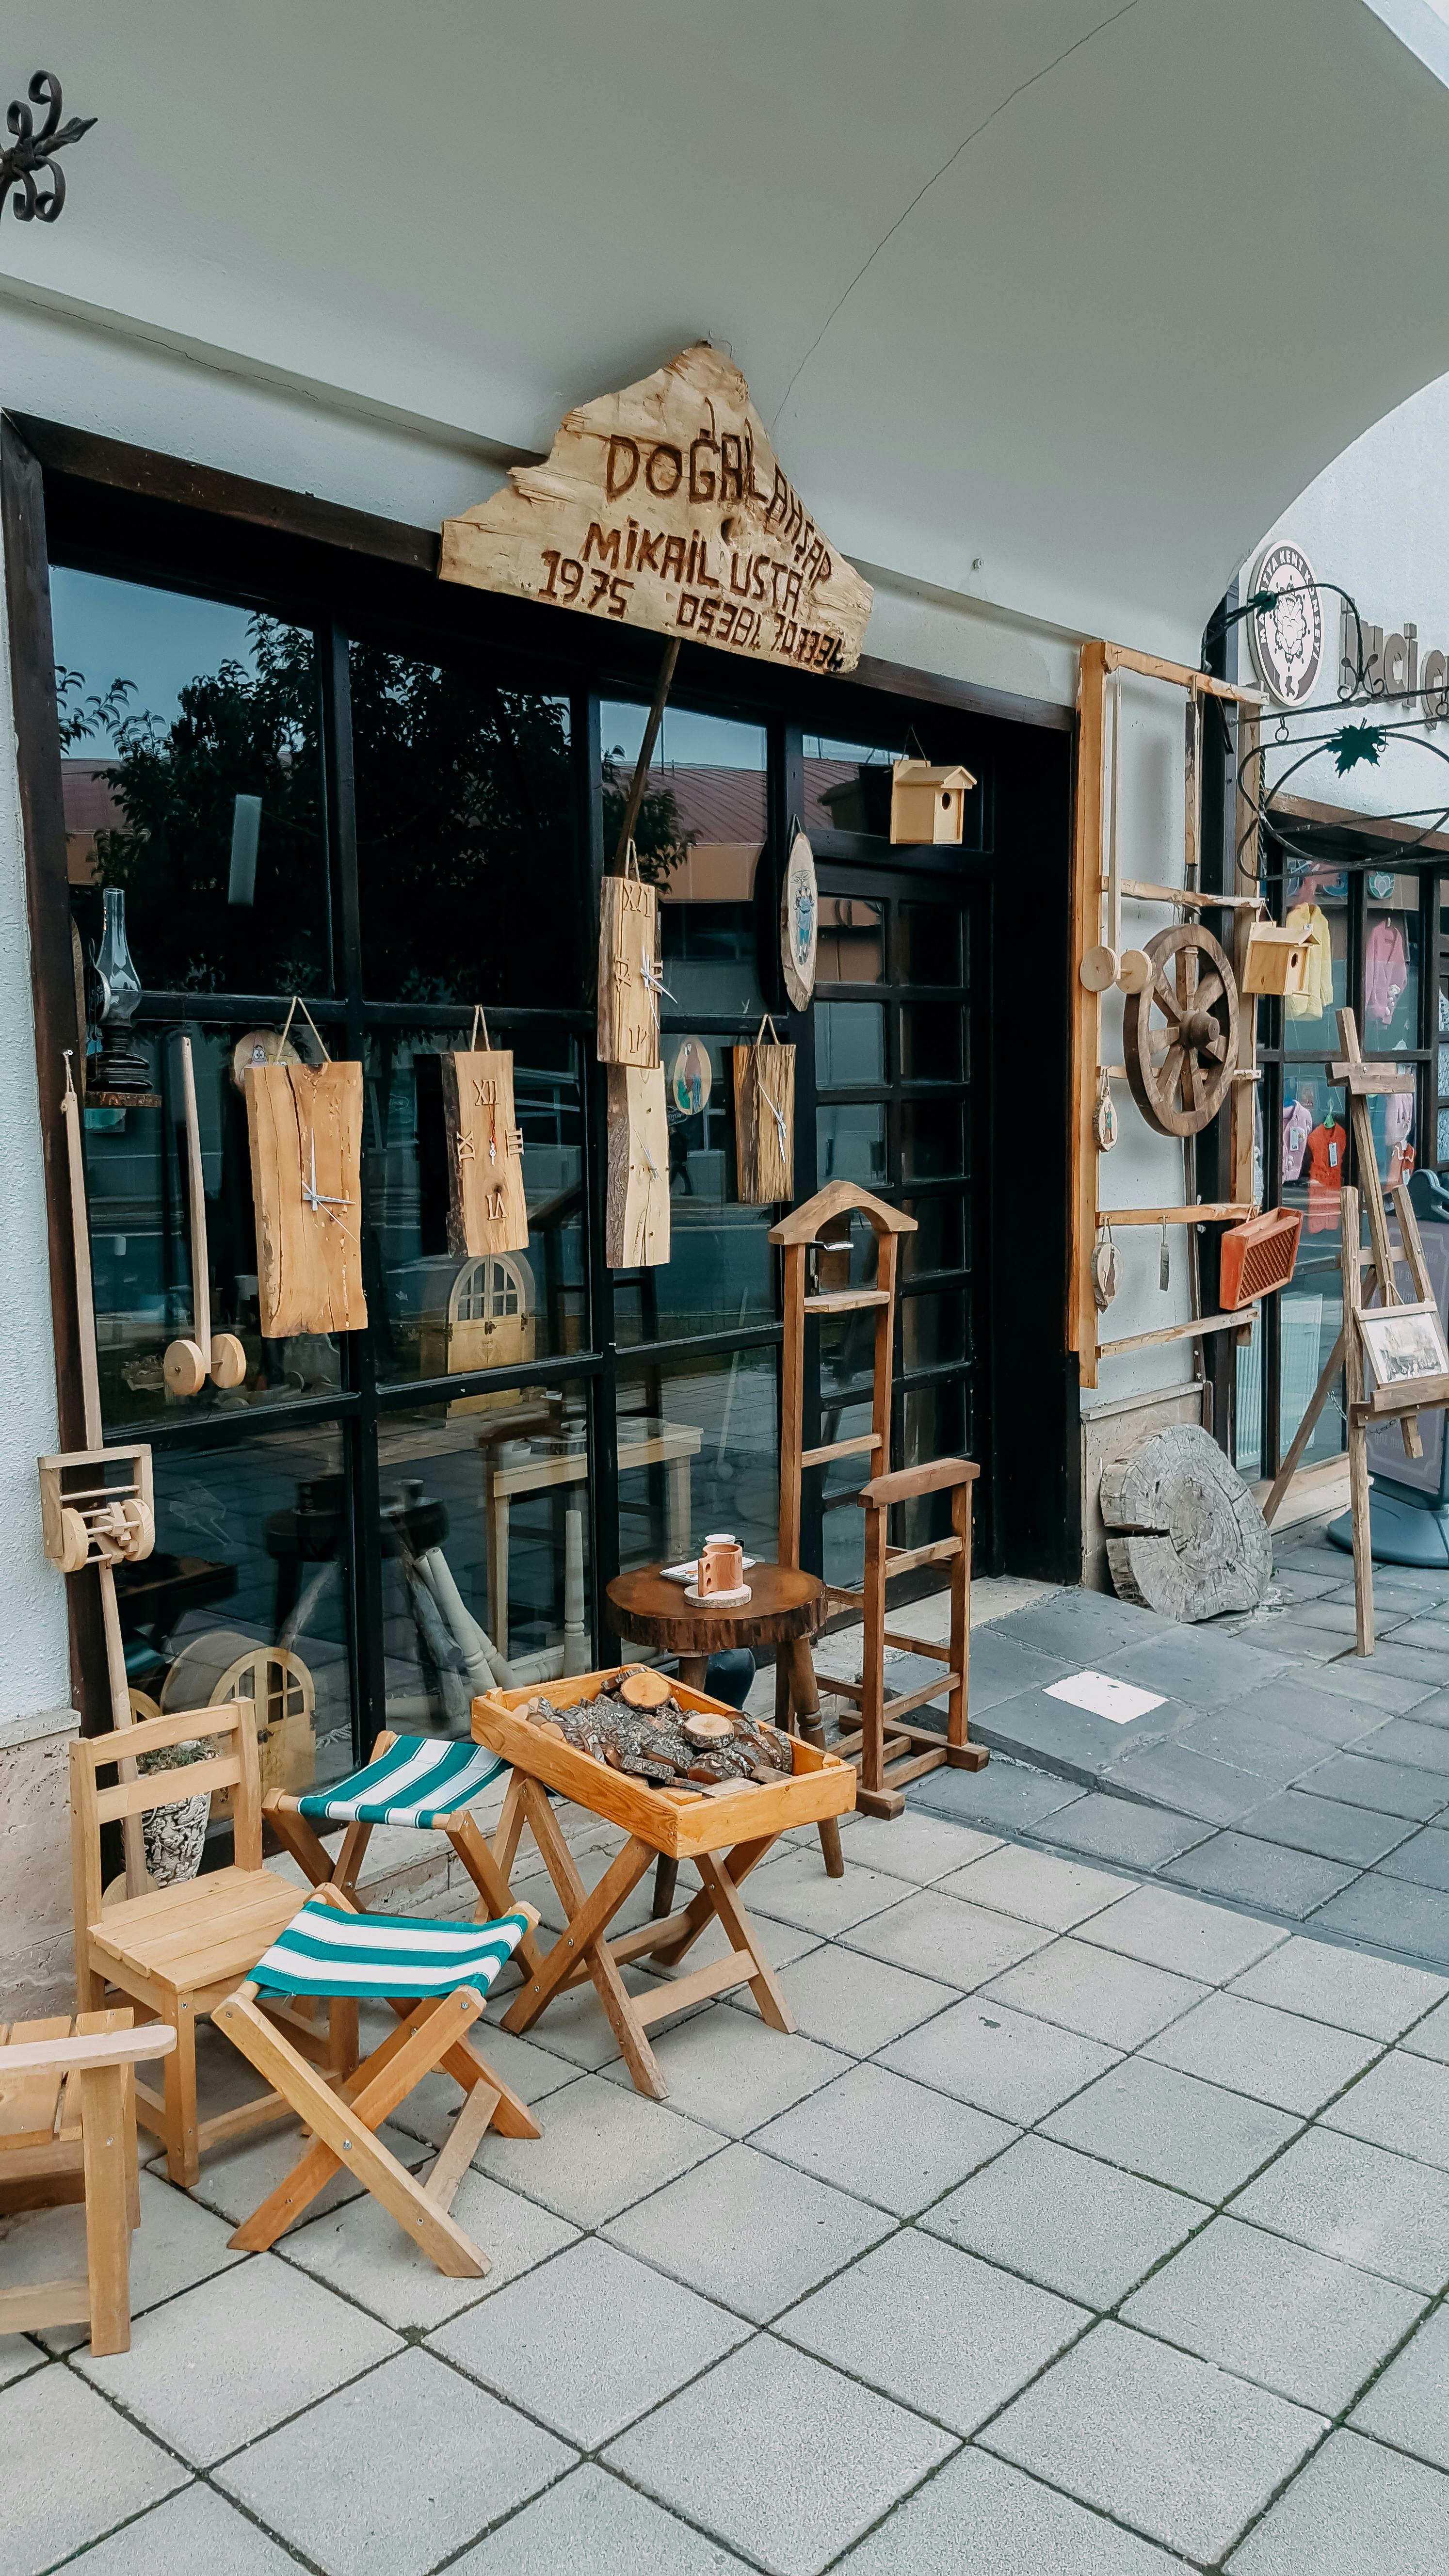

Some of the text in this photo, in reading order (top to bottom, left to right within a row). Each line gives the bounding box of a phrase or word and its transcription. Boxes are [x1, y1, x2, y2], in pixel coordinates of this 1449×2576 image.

[765, 466, 832, 594] AHŞAP
[1279, 549, 1304, 572] KENT
[538, 549, 634, 619] 1975
[729, 552, 804, 618] USTA
[472, 1079, 499, 1106] XII
